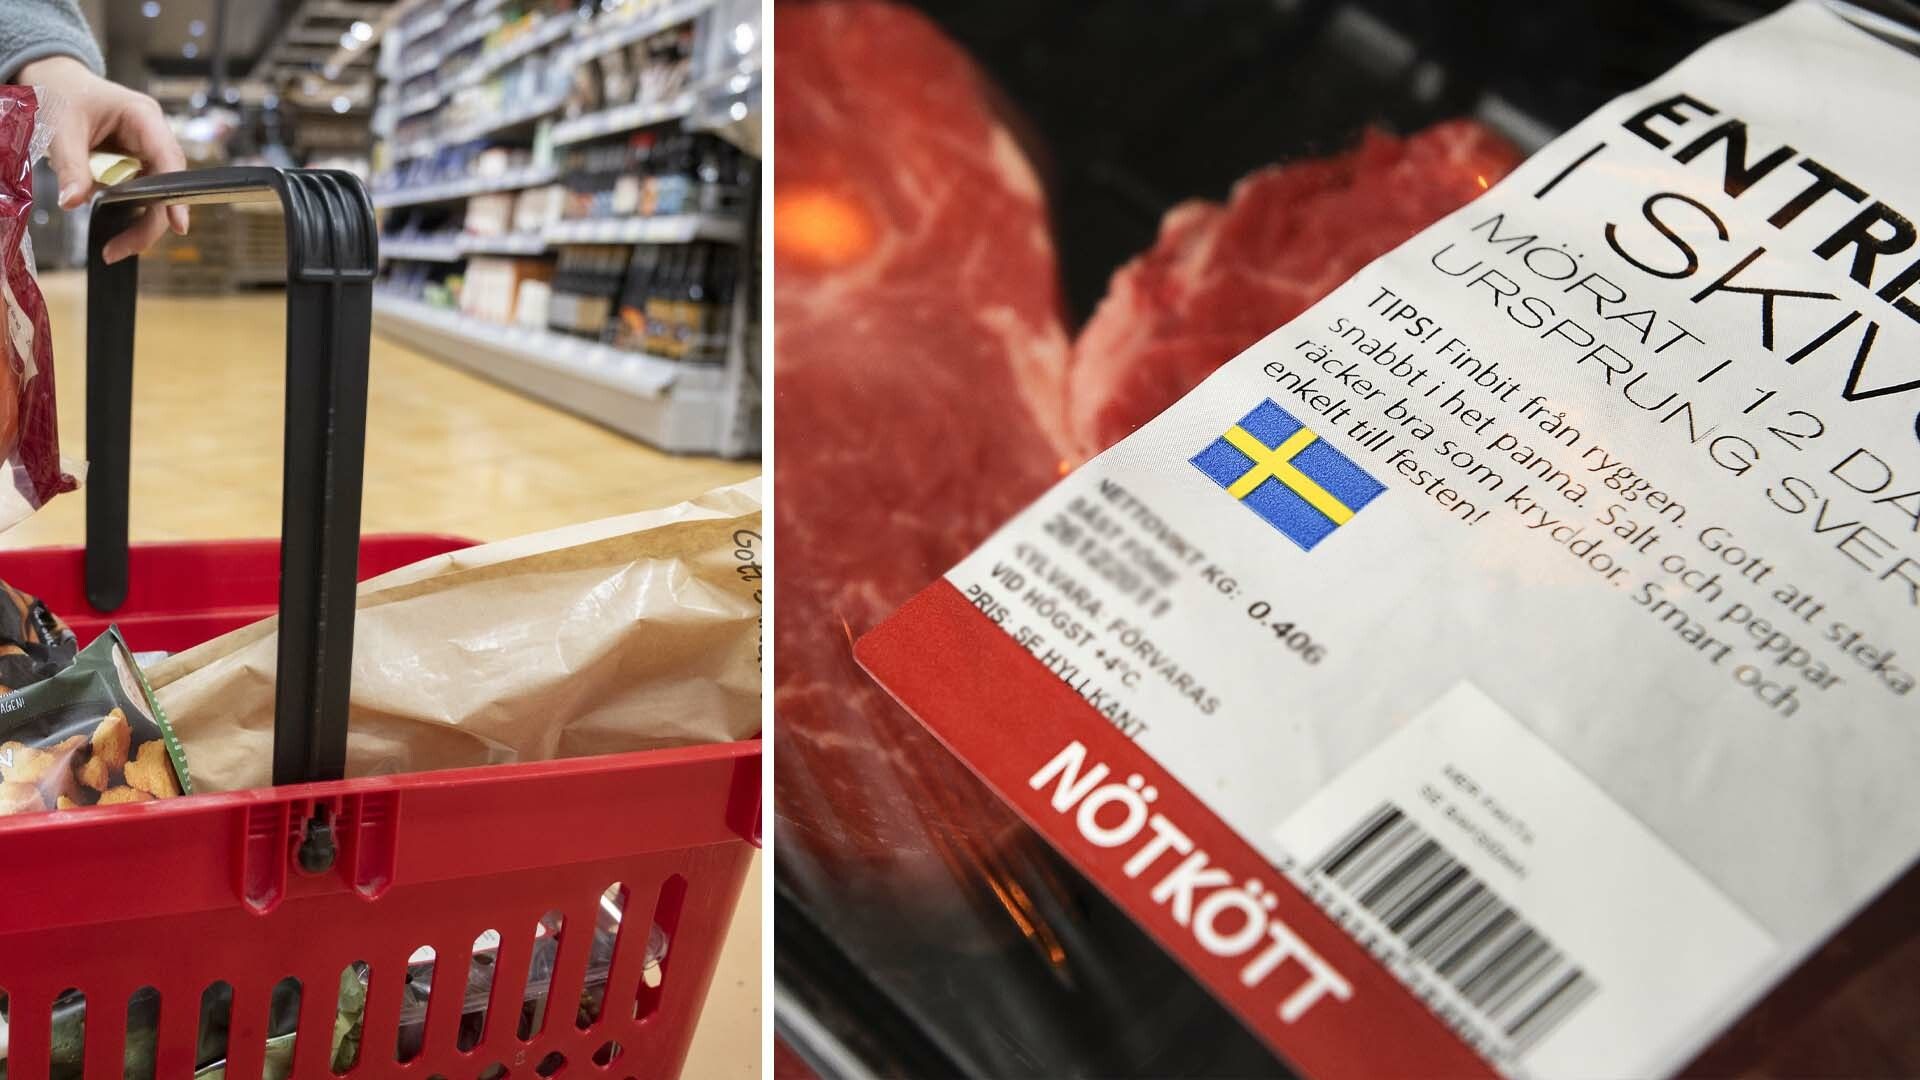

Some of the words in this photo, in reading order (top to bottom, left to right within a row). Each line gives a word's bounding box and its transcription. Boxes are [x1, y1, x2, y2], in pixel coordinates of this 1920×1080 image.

[1534, 142, 1605, 199] I
[1264, 358, 1354, 425] enkelt
[1346, 417, 1386, 454] till
[1385, 441, 1490, 527] festen!
[1430, 243, 1759, 478] URSPRUNG
[1470, 212, 1704, 352] MÖRAT
[1697, 358, 1731, 383] I
[1743, 387, 1824, 451] 12
[991, 561, 1024, 591] VID
[1023, 584, 1096, 647] HÖGST
[1295, 340, 1394, 402] räcker
[1383, 397, 1434, 443] bra
[1434, 440, 1506, 492] som
[1505, 484, 1627, 586] kryddor.
[1632, 581, 1731, 669] Smart
[1734, 664, 1802, 720] och
[1329, 316, 1430, 390] snabbt
[1424, 381, 1446, 398] i
[1441, 388, 1499, 435] het
[1490, 426, 1588, 510] panna.
[1596, 504, 1660, 555] Salt
[1660, 555, 1725, 603] och
[1718, 603, 1844, 693] peppar
[1367, 287, 1443, 343] TIPS!
[1437, 336, 1521, 404] Finbit
[1518, 395, 1581, 449] från
[1583, 443, 1687, 528] ryggen.
[1698, 525, 1774, 584] Gott
[1772, 584, 1824, 623] att
[1824, 621, 1915, 696] steka
[1247, 599, 1327, 667] 0.406
[1029, 739, 1354, 1024] NÖTKÖTT
